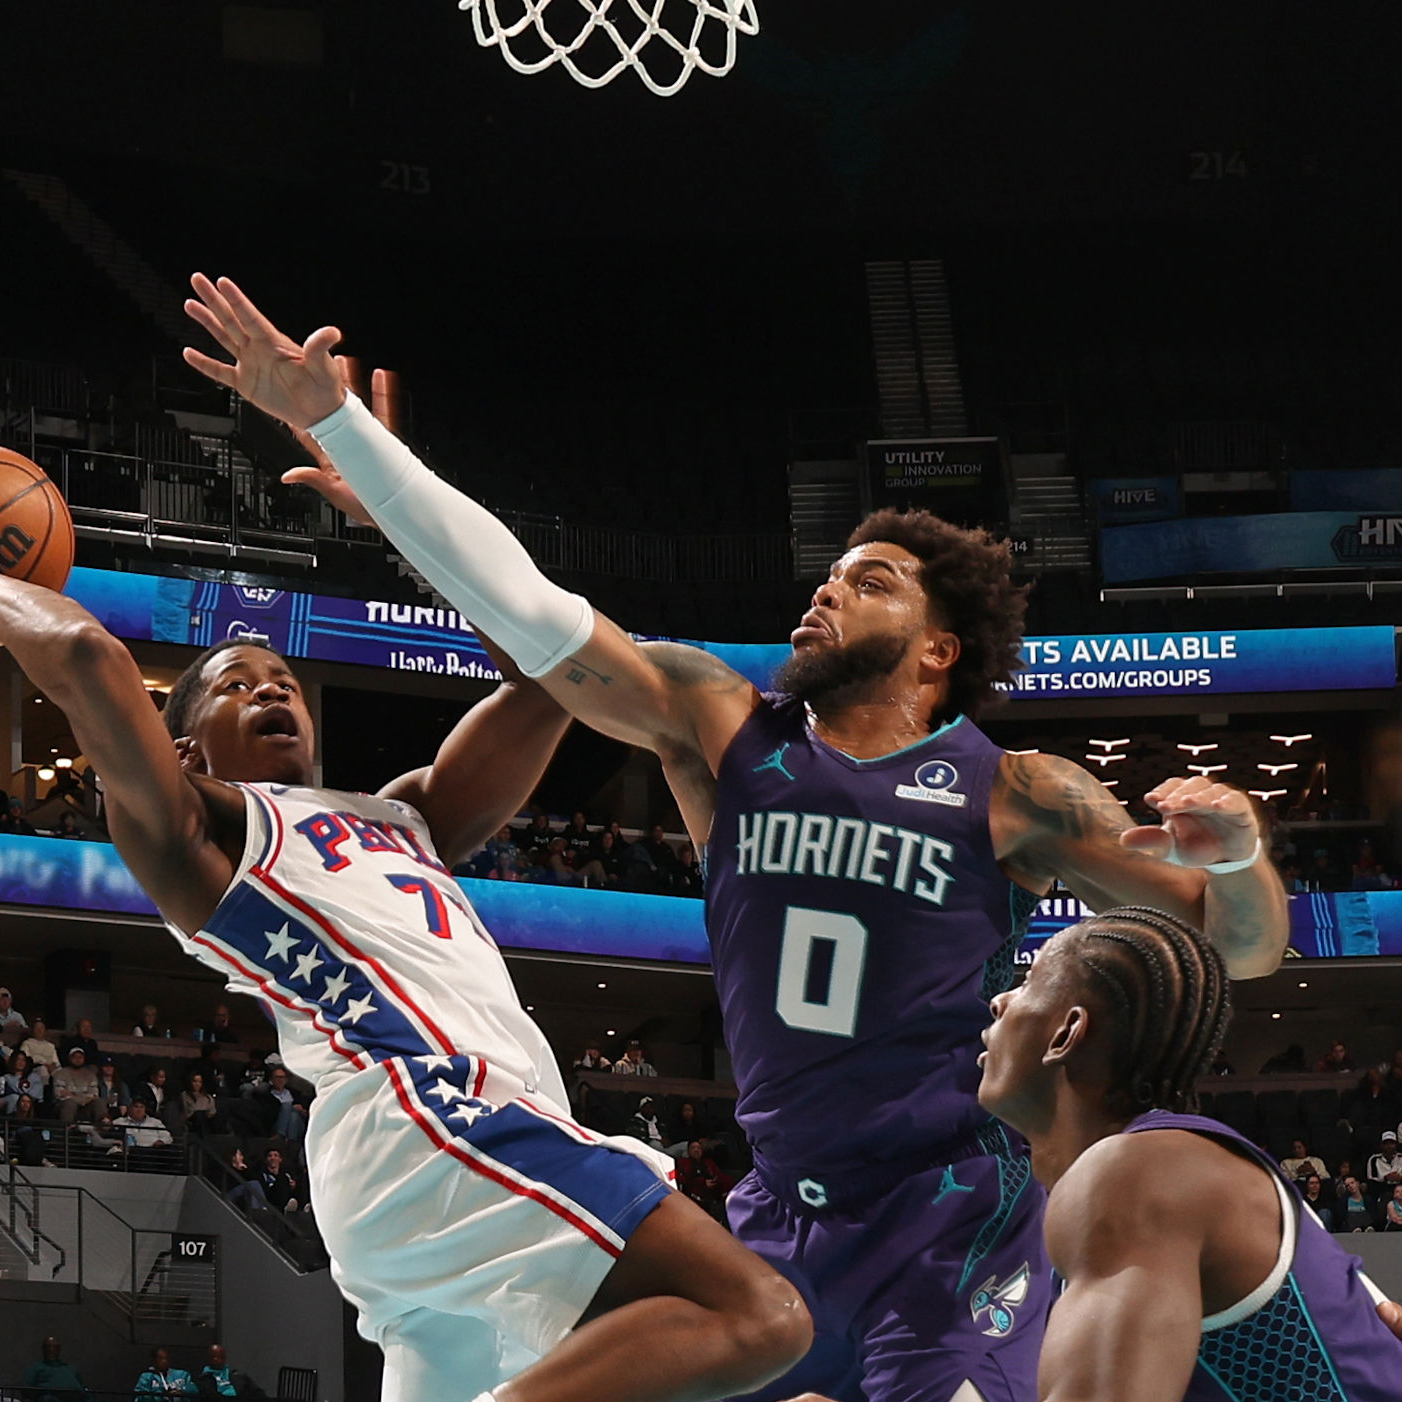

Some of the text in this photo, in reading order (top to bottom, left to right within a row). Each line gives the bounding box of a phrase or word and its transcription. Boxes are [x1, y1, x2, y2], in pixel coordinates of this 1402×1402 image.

[1189, 152, 1247, 180] 214
[381, 160, 430, 195] 213
[885, 451, 945, 464] UTILITY
[904, 463, 982, 476] INNOVATION
[885, 478, 925, 488] GROUP
[1113, 488, 1157, 504] HIVE
[1070, 635, 1238, 663] AVAILABLE
[735, 810, 957, 907] HORNETS
[776, 904, 869, 1040] 0
[178, 1240, 207, 1257] 107
